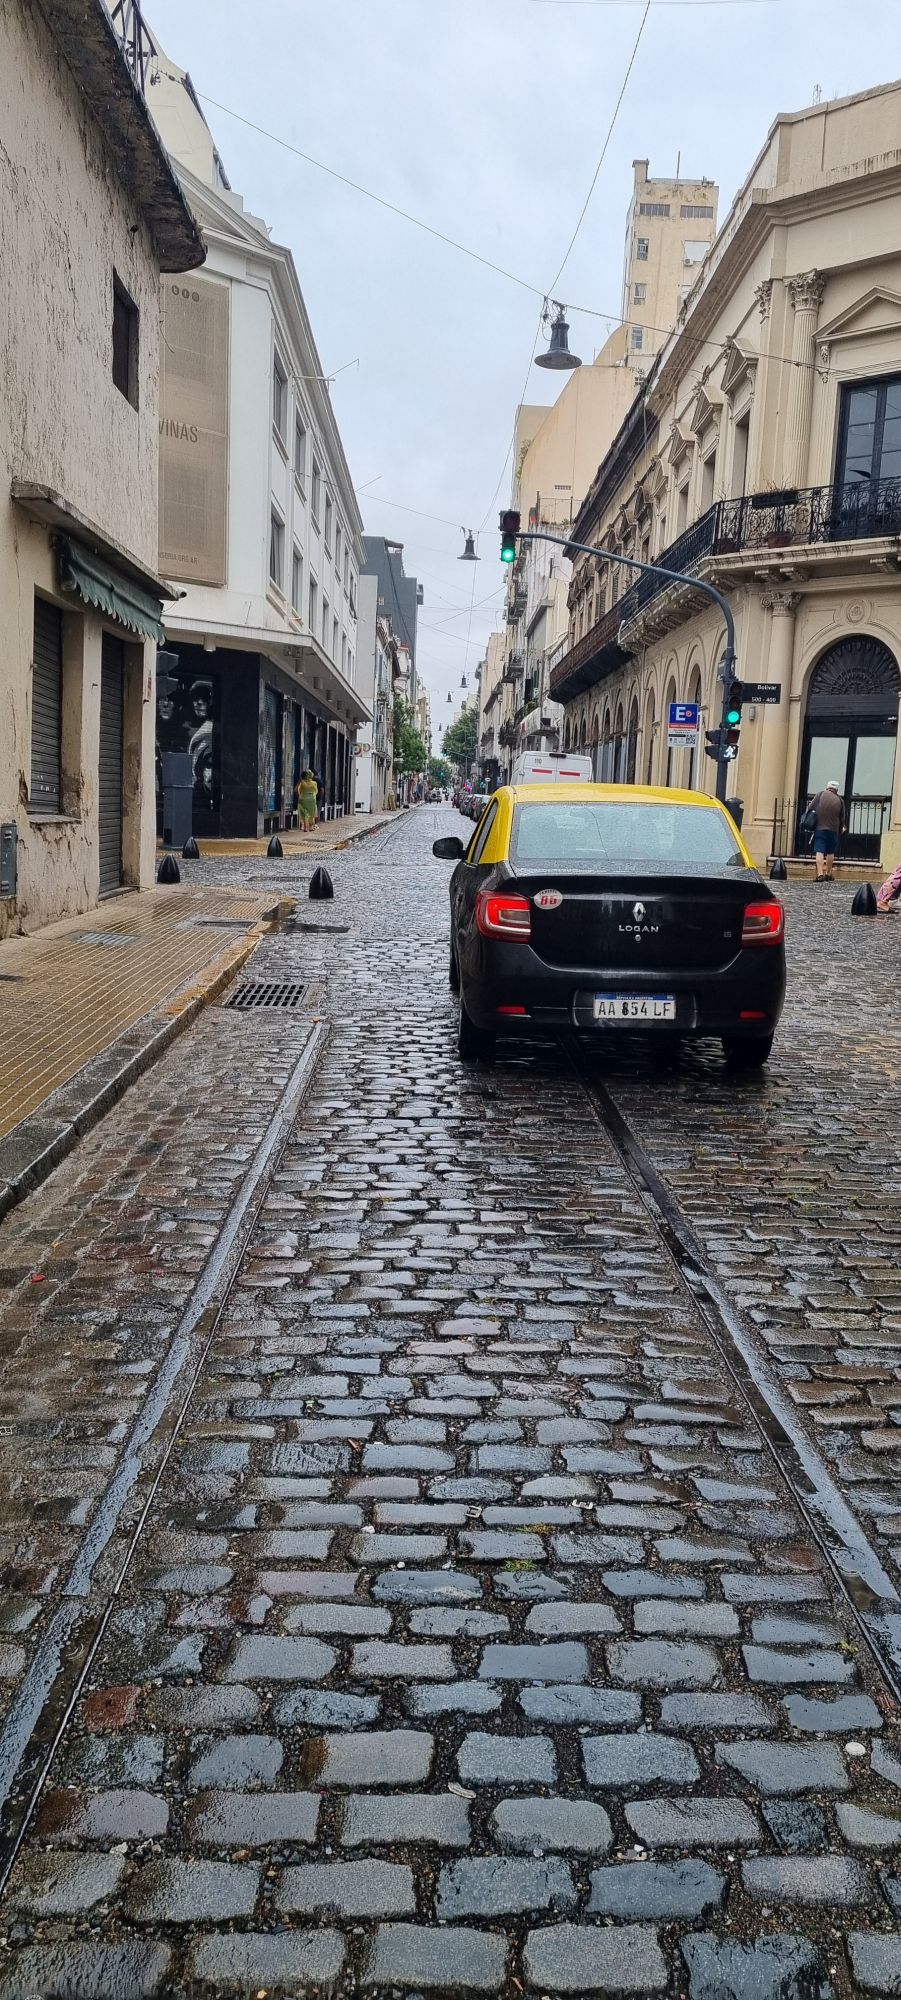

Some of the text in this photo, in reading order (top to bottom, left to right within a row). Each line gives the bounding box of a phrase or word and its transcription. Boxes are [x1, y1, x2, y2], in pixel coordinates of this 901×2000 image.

[675, 706, 686, 721] E
[618, 924, 659, 932] LOGAN
[598, 1001, 671, 1017] AA 854 LF
